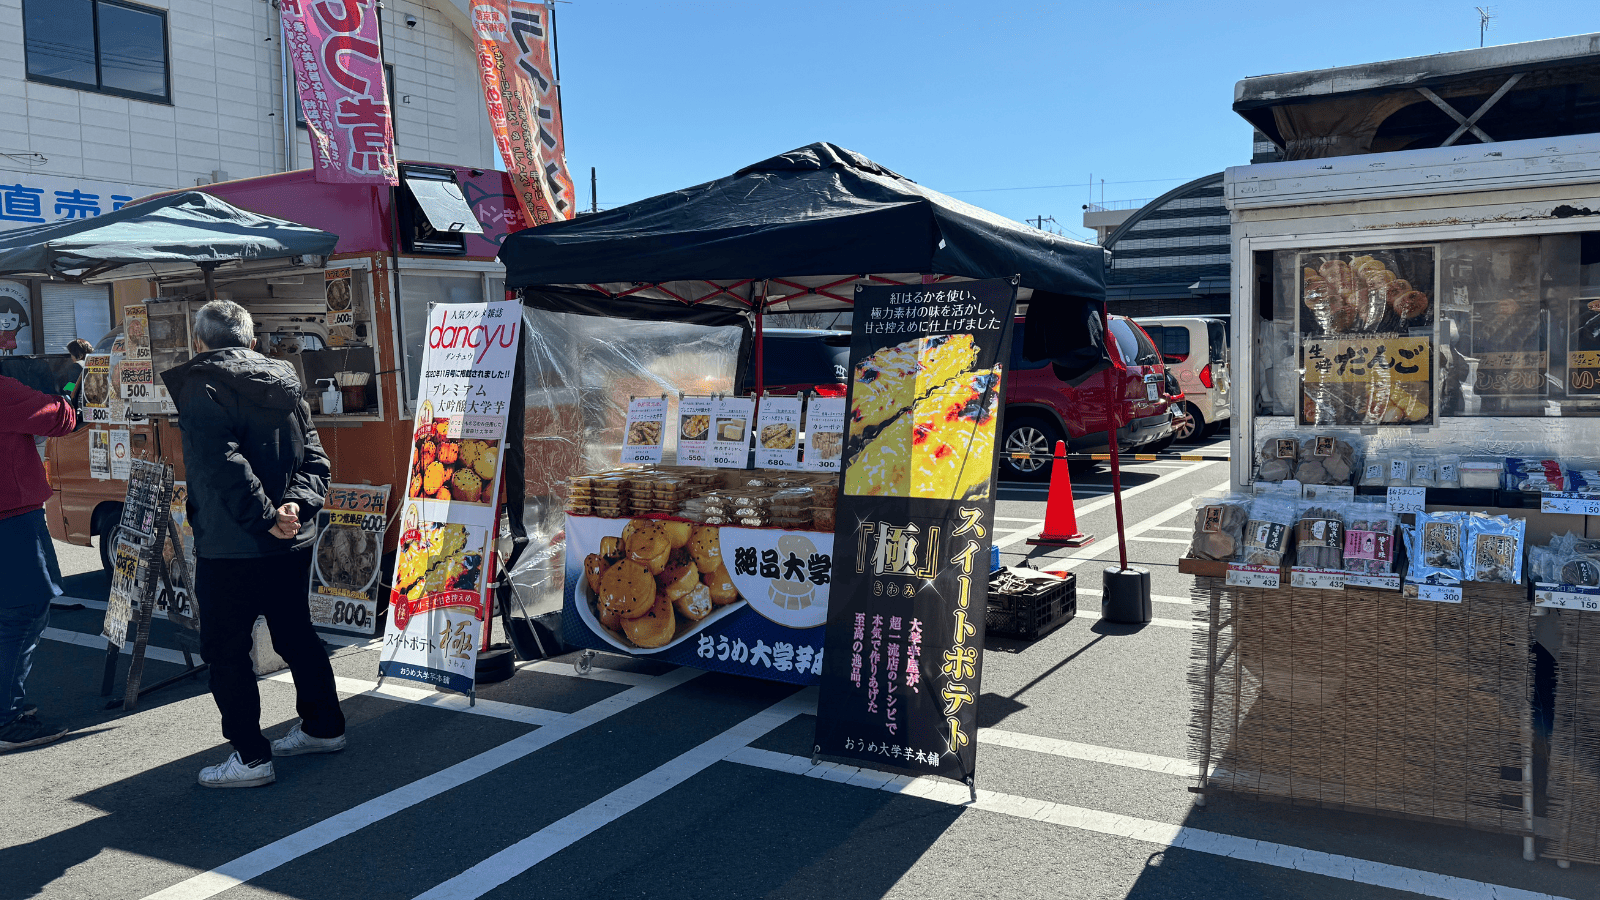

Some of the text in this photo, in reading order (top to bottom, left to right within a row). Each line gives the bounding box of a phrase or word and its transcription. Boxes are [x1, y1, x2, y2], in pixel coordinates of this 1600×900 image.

[889, 290, 977, 305] 紅はるかを使い、
[870, 303, 995, 319] 極力素材の味を活かし、
[864, 317, 1001, 334] 甘さ控えめに仕上げました
[429, 310, 516, 364] dancyu
[432, 382, 487, 398] プレミアム
[437, 399, 506, 415] 大吟醸大学芋
[873, 580, 916, 599] きわみ
[1262, 579, 1277, 587] 432
[1581, 601, 1598, 609] 150
[941, 506, 987, 754] スイートポテト
[386, 633, 437, 655] スイートポテト
[850, 612, 866, 689] 至高の逸品。
[867, 613, 884, 714] 本気で作りあげた
[905, 617, 924, 694] 大学芋屋が、
[885, 615, 903, 735] 超一流店のレシピで
[844, 736, 941, 768] おうめ大学芋本舗
